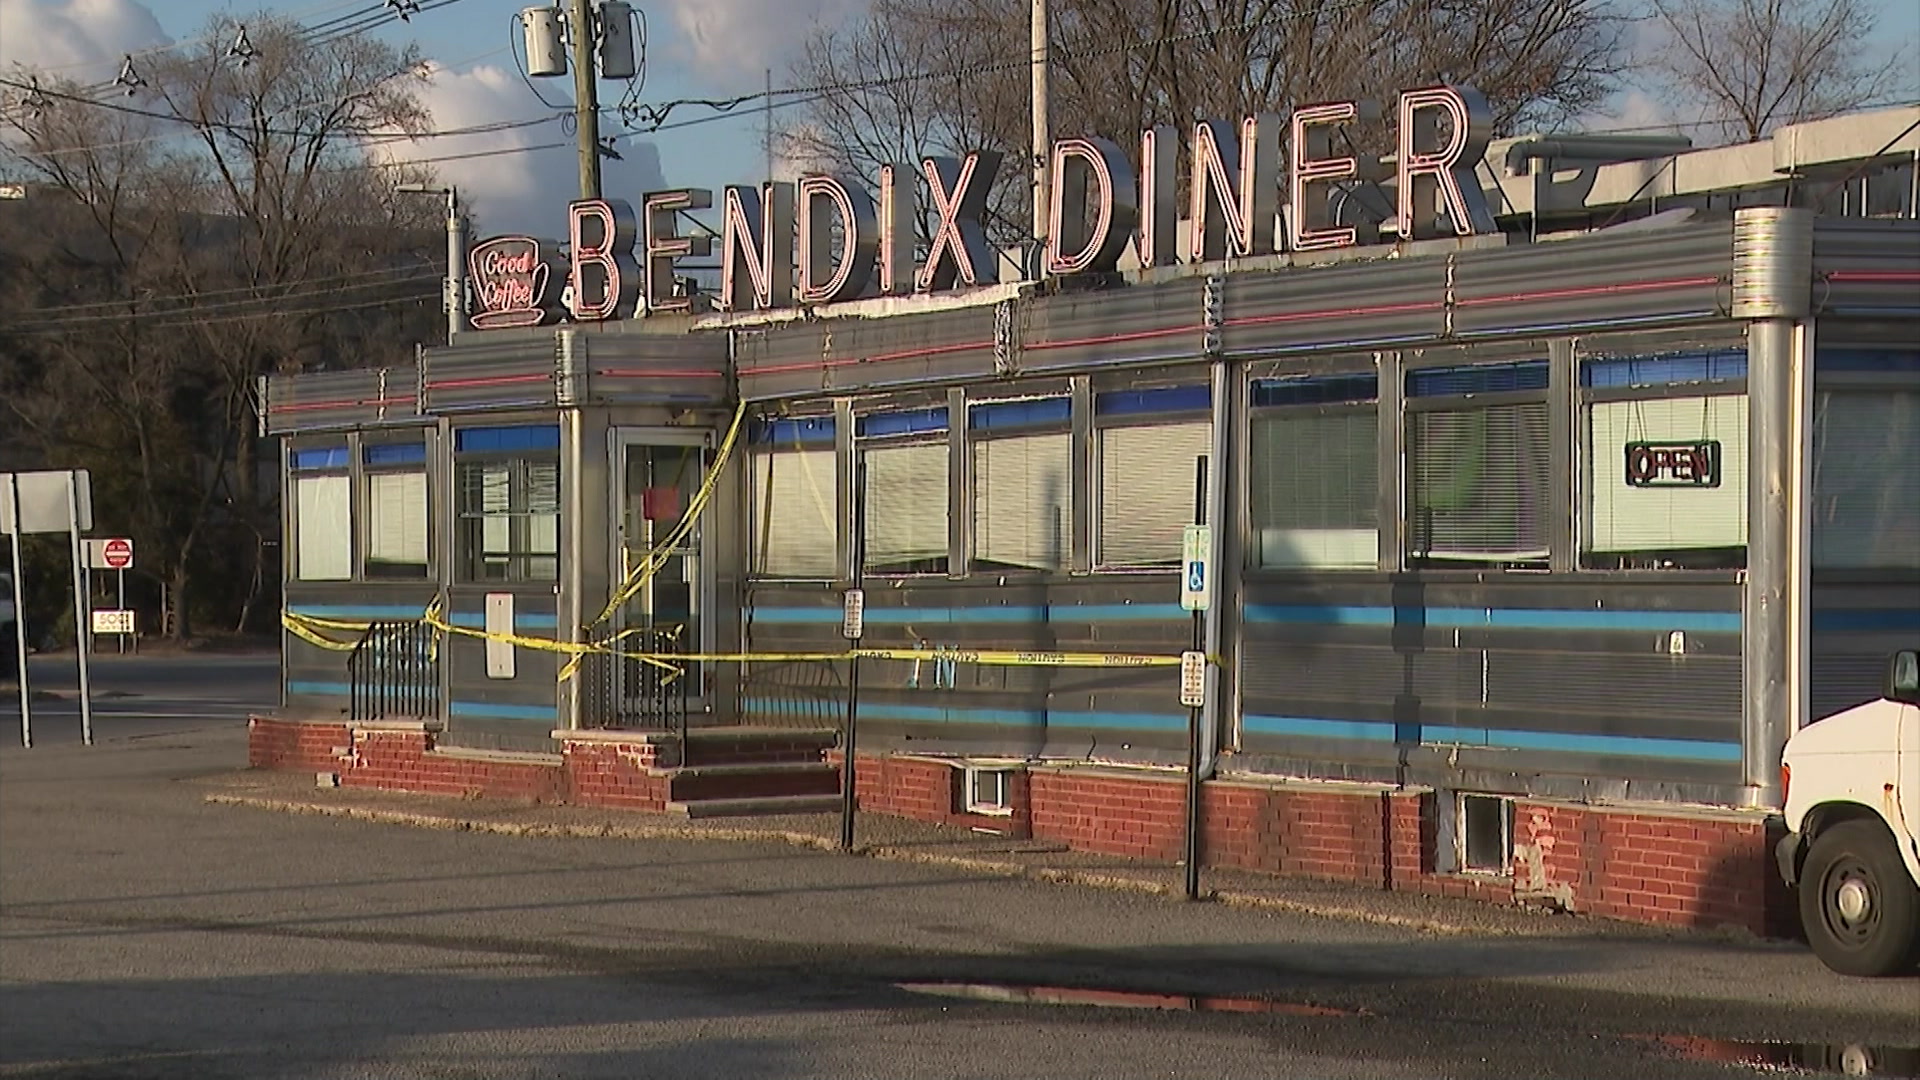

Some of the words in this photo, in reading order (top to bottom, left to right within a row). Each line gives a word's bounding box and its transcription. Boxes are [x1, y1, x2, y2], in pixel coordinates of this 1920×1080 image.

[568, 150, 990, 320] BENDIX
[1047, 86, 1478, 273] DINER
[485, 250, 530, 275] Good
[484, 278, 530, 311] Coffee
[1628, 444, 1712, 484] OPEN
